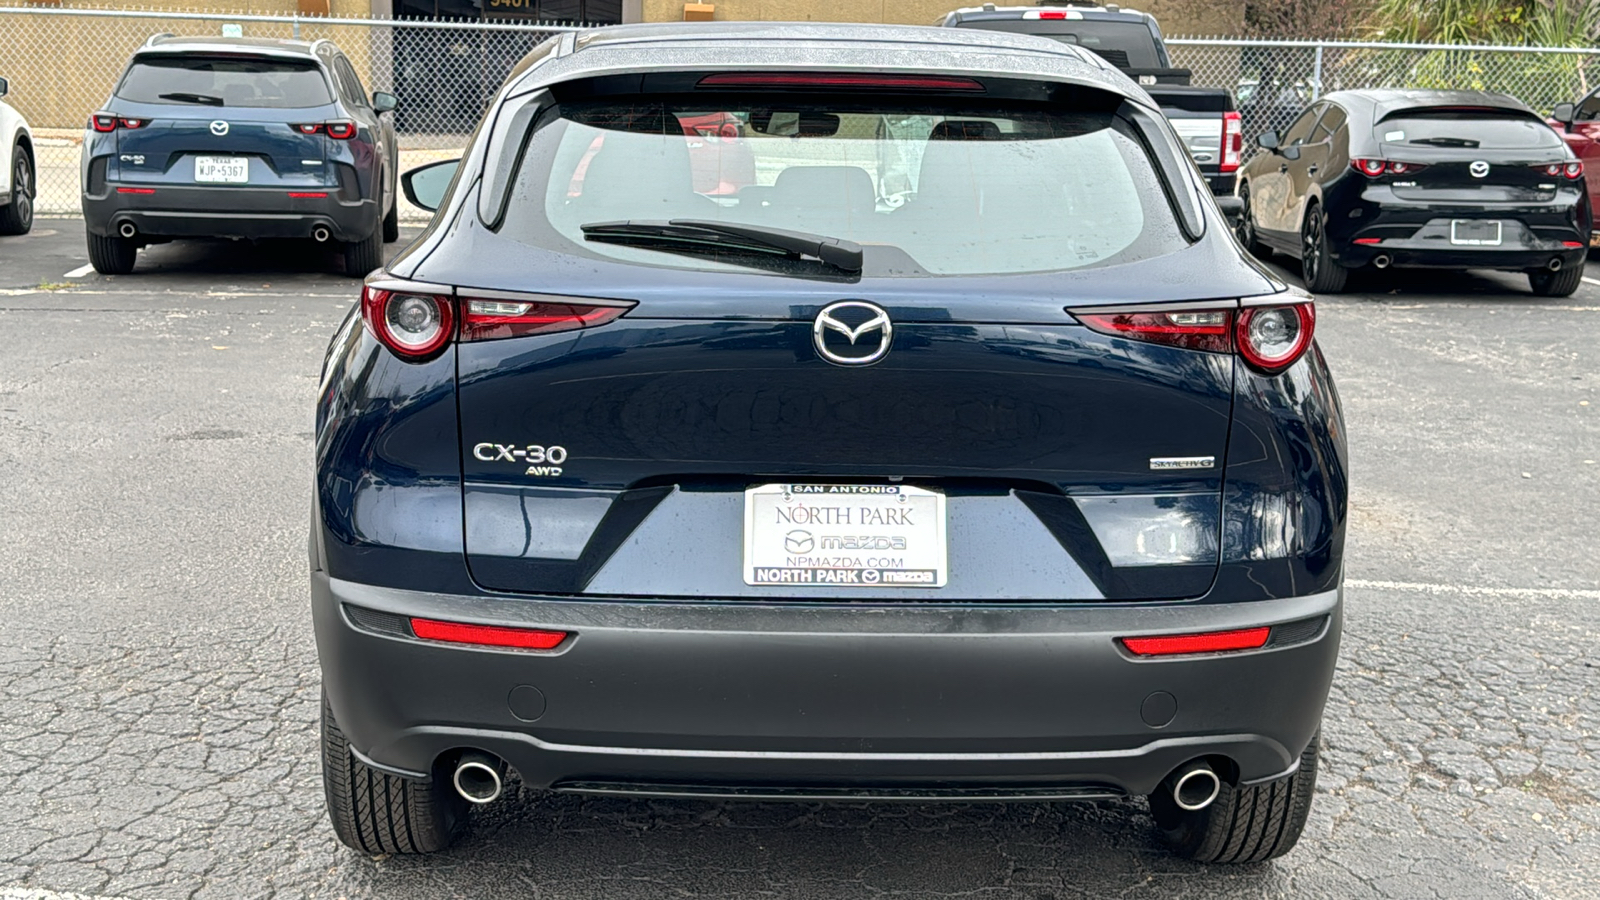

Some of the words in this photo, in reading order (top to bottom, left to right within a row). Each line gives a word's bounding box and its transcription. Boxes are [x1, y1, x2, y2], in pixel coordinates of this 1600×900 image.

[473, 442, 567, 465] CX-30
[525, 466, 563, 476] AWD
[829, 486, 897, 494] ANTONIO
[775, 506, 851, 525] NORTH
[860, 507, 915, 526] PARK
[820, 535, 907, 550] mazda
[786, 556, 904, 568] NPMAZDA.COM
[757, 569, 812, 582] NORTH
[816, 570, 859, 583] PARK
[882, 571, 934, 582] mazda
